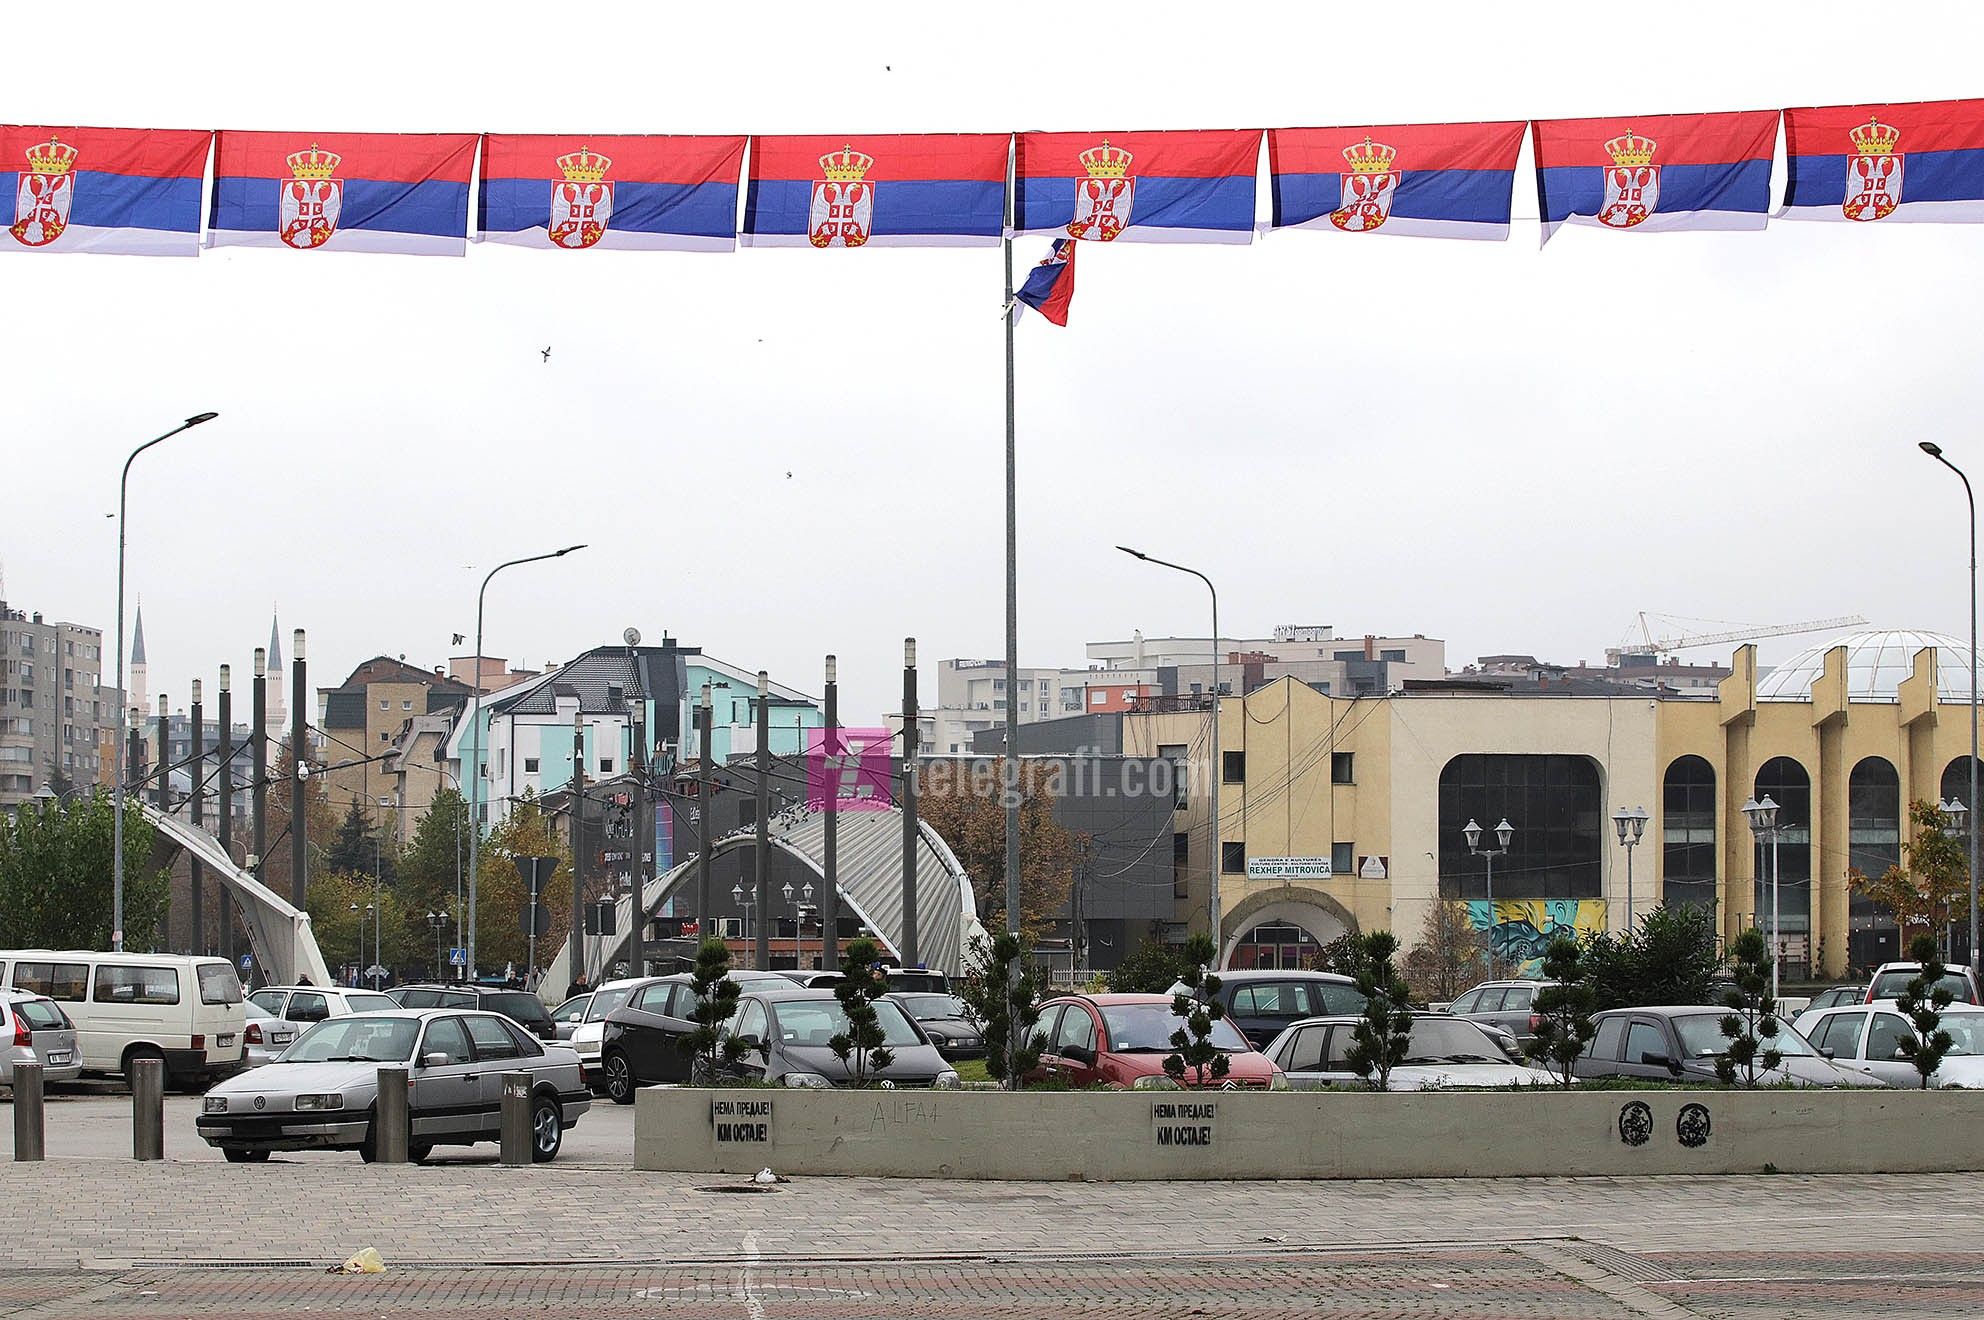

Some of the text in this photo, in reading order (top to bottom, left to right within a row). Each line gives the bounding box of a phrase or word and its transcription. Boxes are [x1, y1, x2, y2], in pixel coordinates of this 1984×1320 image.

[1249, 866, 1331, 875] REXHEP MITROVICA
[714, 1101, 770, 1118] НЕМА ПРЕДАЈЕ!
[1154, 1104, 1214, 1120] НЕМА ПРЕДАЈЕ!
[717, 1123, 768, 1142] КМ ОСТАЈЕ!
[1157, 1126, 1211, 1145] КМ ОСТАЈЕ!
